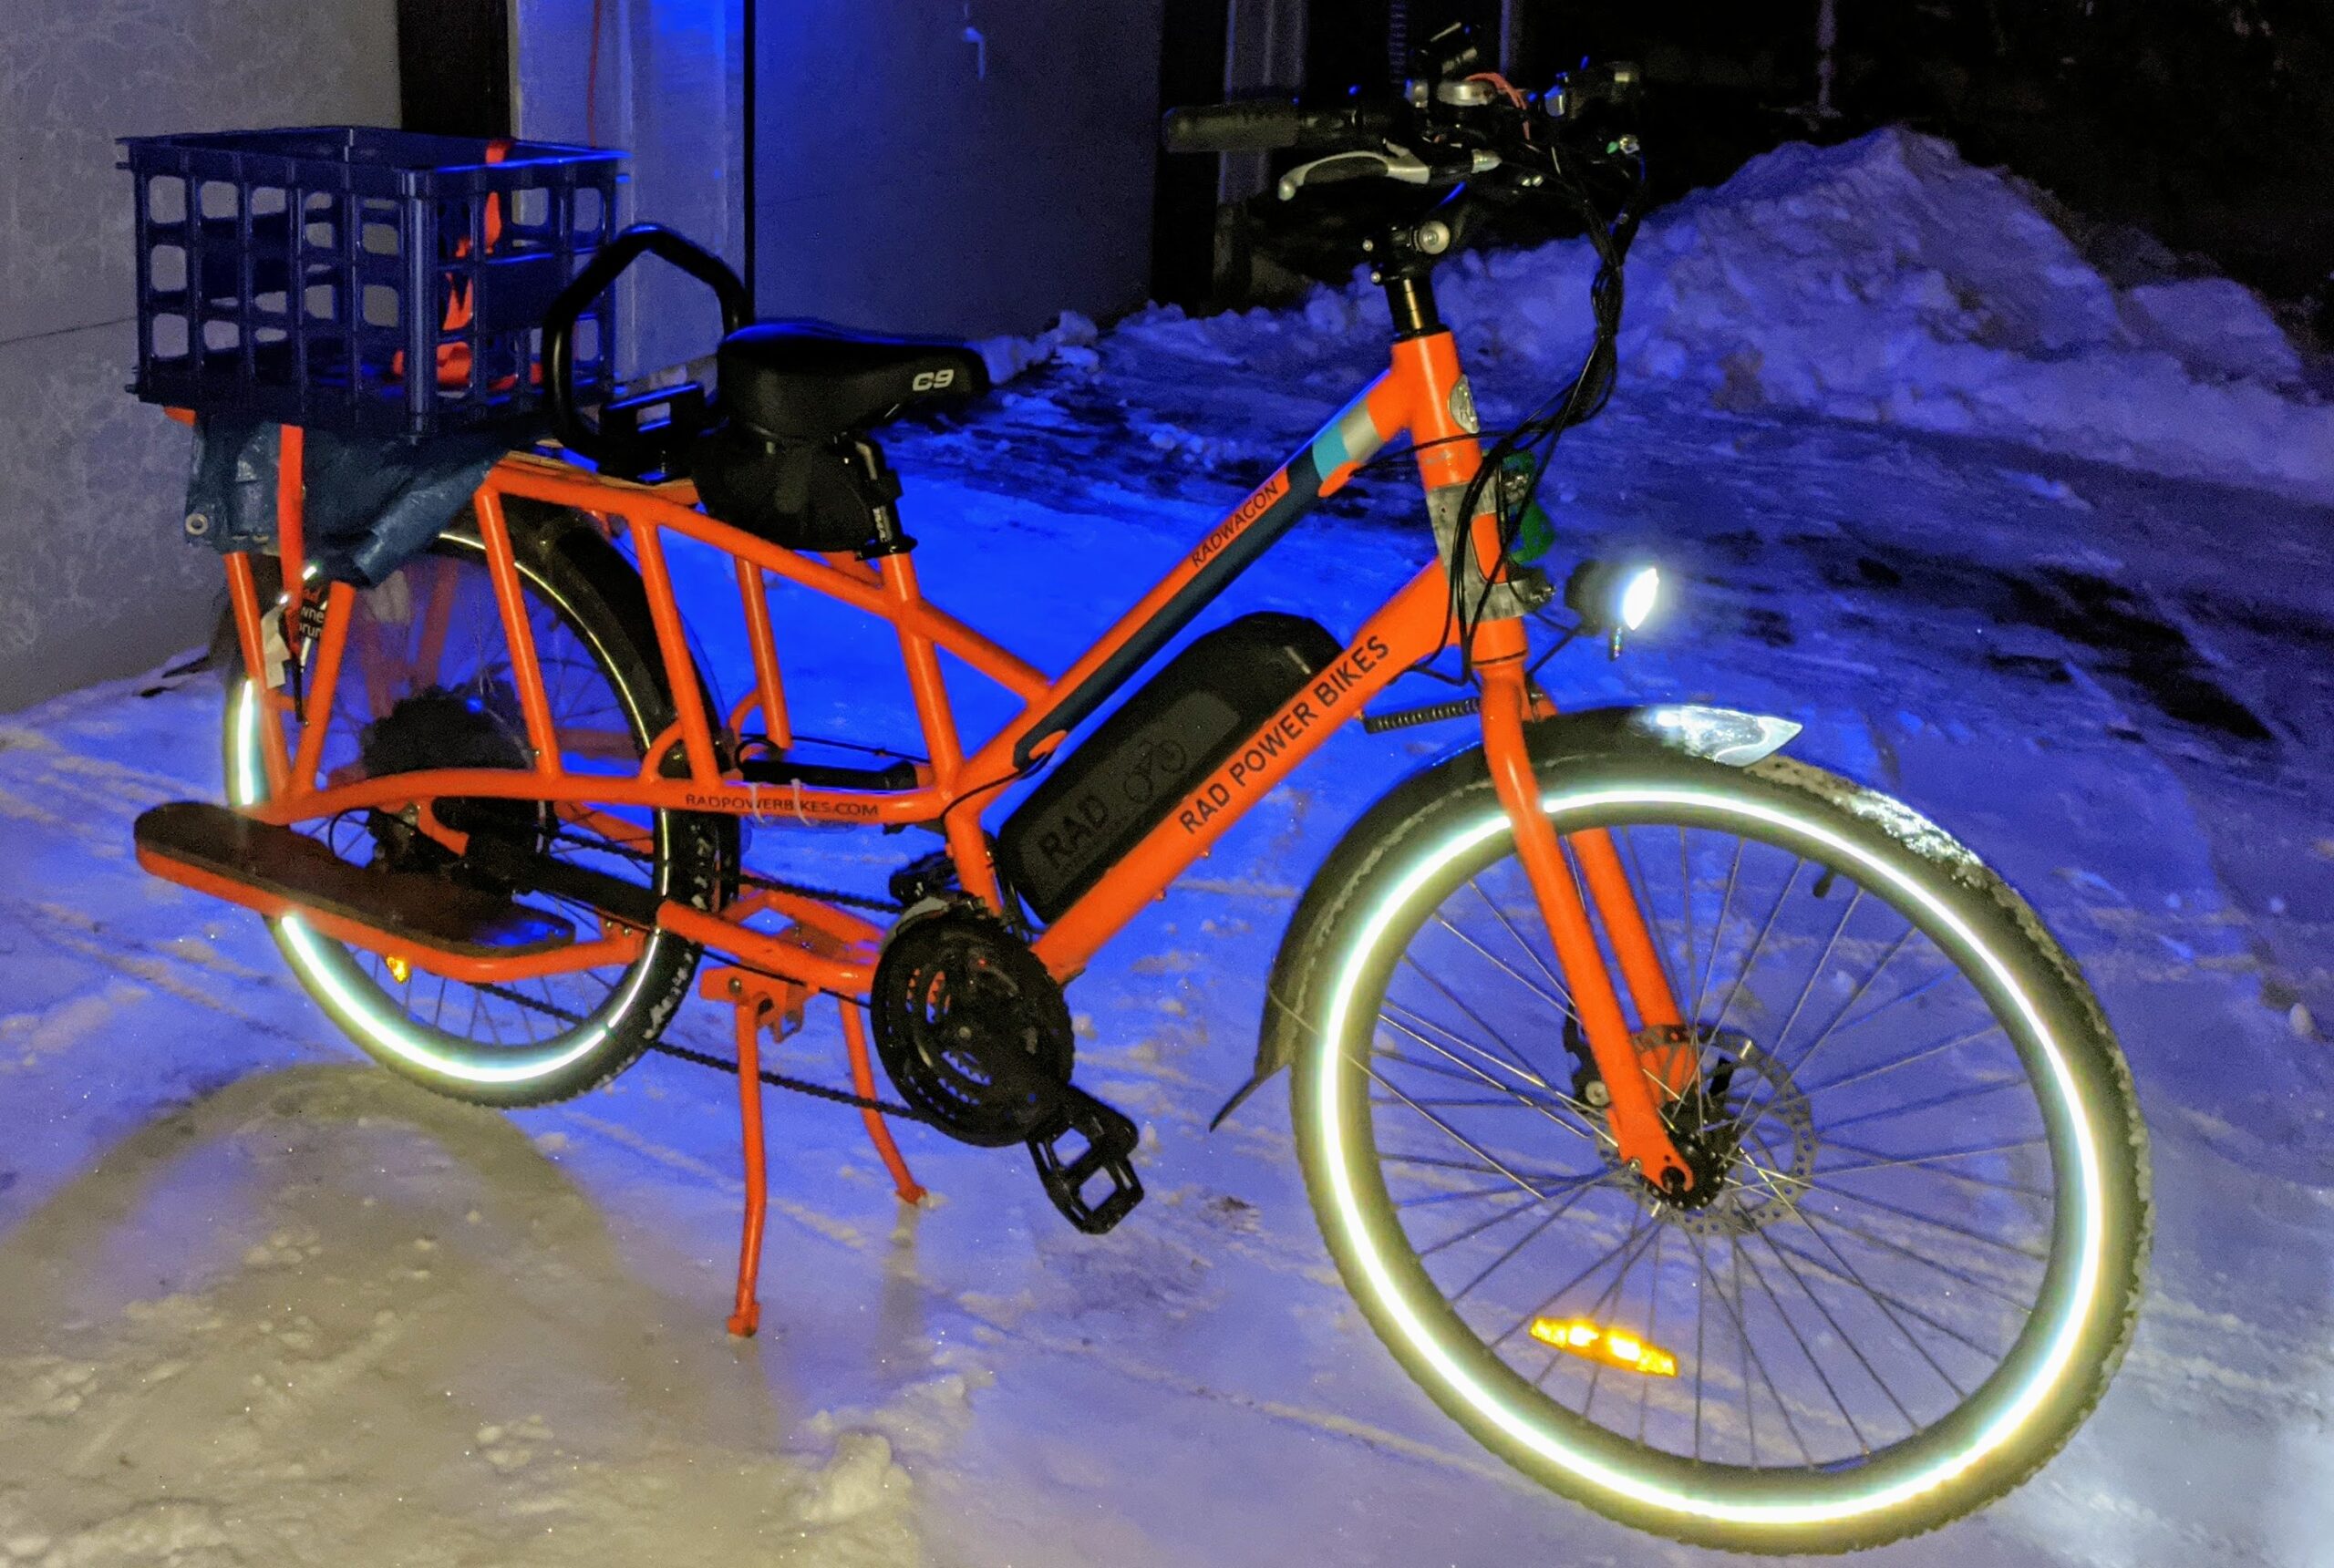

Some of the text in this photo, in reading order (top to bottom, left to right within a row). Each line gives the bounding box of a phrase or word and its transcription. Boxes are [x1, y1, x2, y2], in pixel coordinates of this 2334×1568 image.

[913, 369, 955, 391] C9
[1191, 481, 1279, 568] RADWAGON
[1180, 635, 1389, 834] RAD POWER BIKES
[686, 793, 879, 816] RADPOWERBKES.COM
[1038, 795, 1109, 870] RAD
